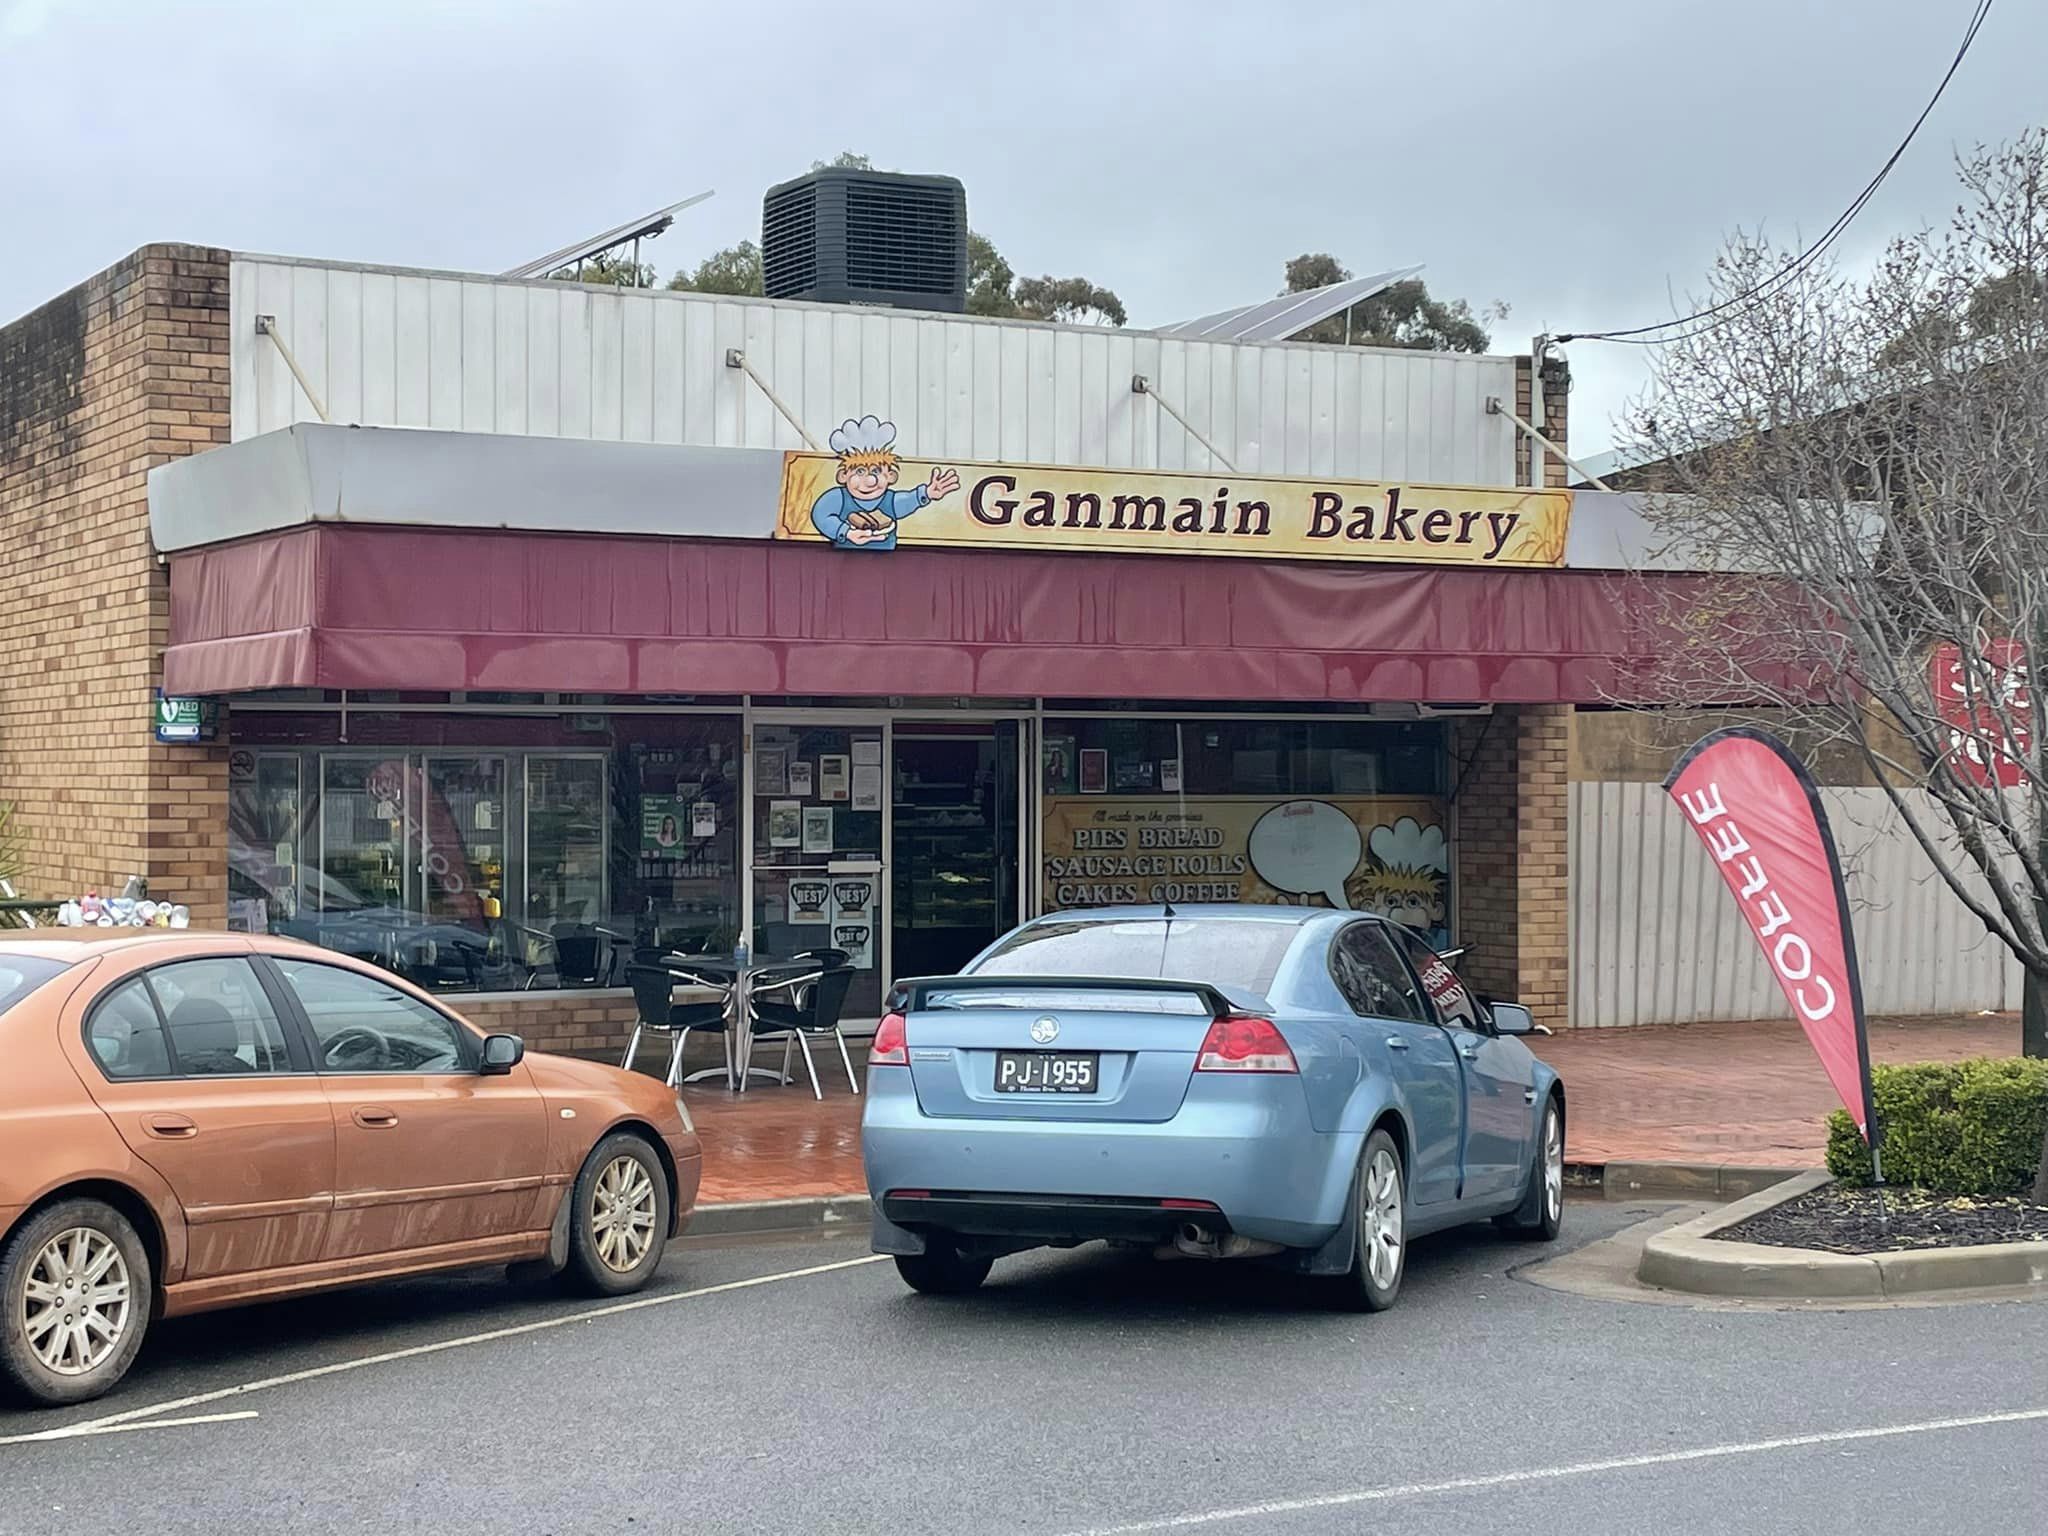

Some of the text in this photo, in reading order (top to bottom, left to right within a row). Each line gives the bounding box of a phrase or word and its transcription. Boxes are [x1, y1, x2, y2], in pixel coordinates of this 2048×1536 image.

[969, 476, 1521, 560] Ganmain Bakery
[179, 701, 199, 712] AED
[1074, 827, 1223, 850] PIES BREAD
[1050, 854, 1246, 877] SAUSAGE ROLLS
[839, 890, 866, 904] BEST
[1057, 882, 1240, 904] CAKES COFFEE
[1001, 1060, 1092, 1085] PJ-1955
